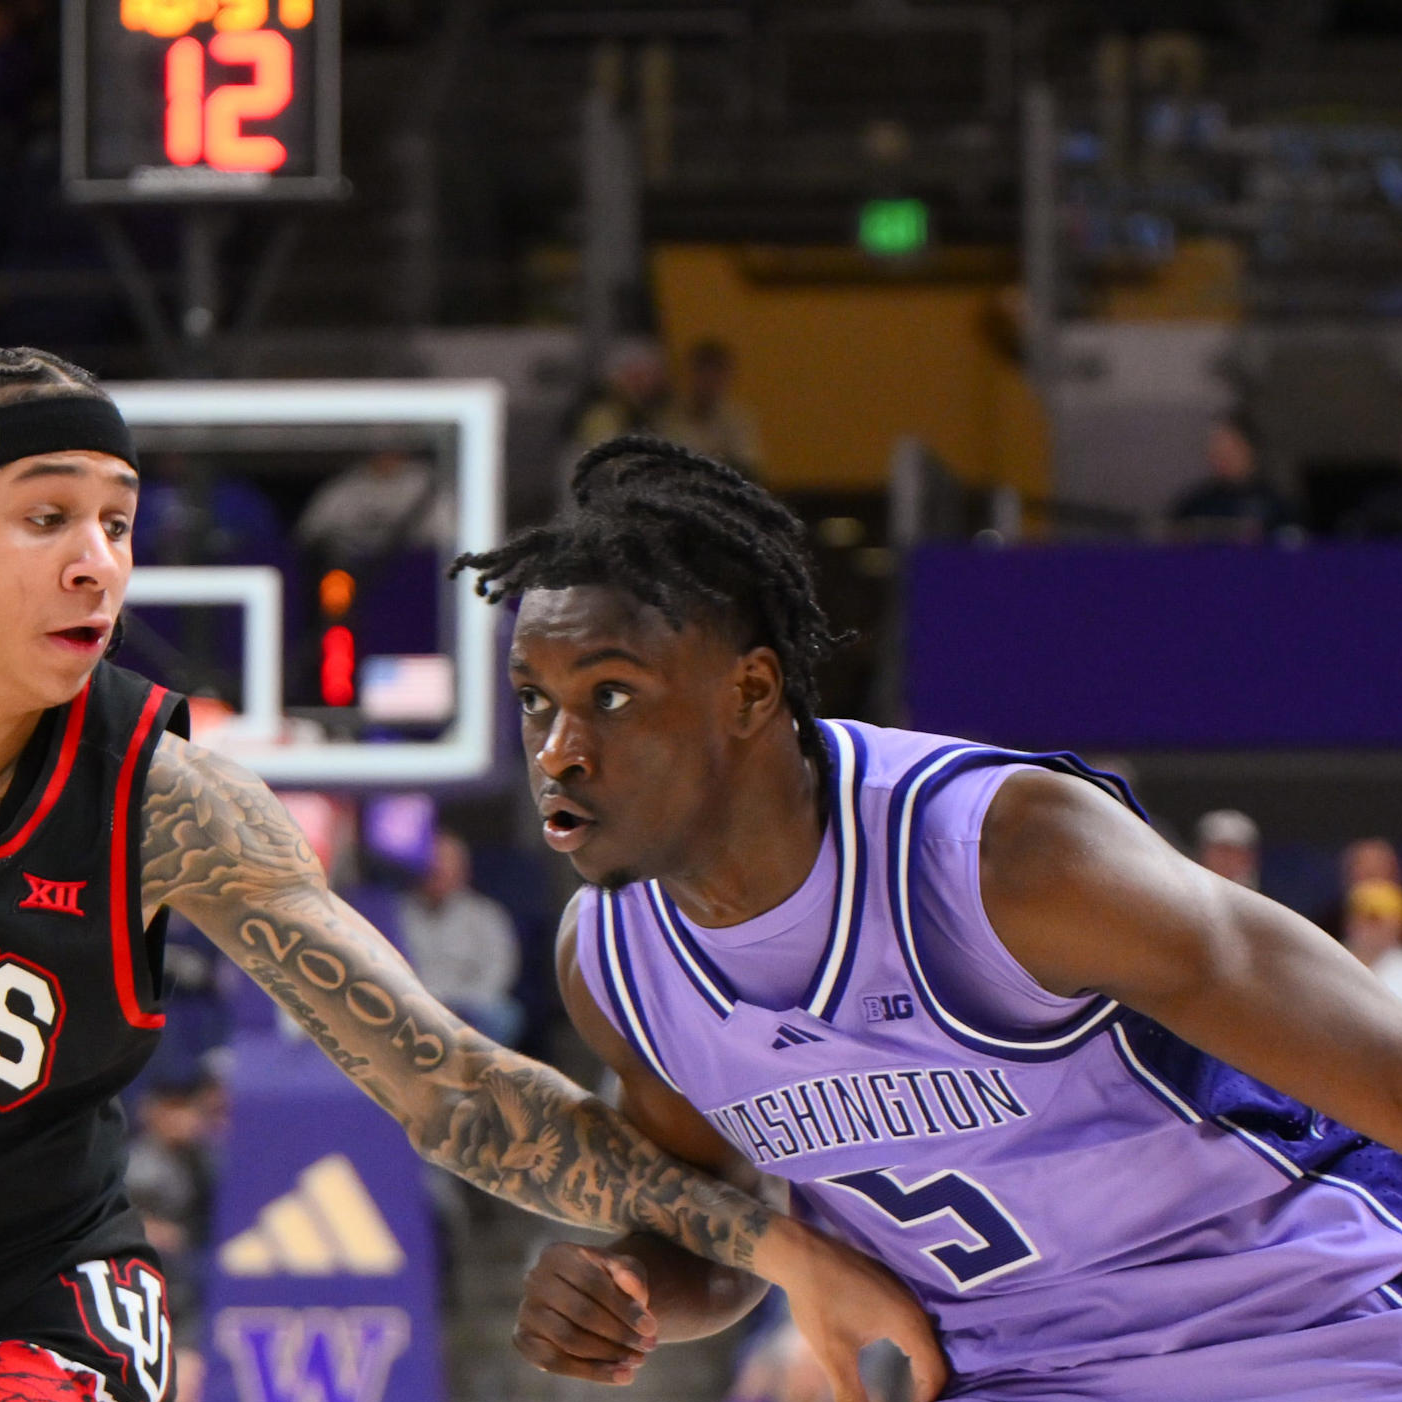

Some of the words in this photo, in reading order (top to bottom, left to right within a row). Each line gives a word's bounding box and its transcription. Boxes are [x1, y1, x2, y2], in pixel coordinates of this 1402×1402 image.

[165, 29, 293, 173] 12
[18, 871, 88, 918] XII
[240, 918, 445, 1067] 2003
